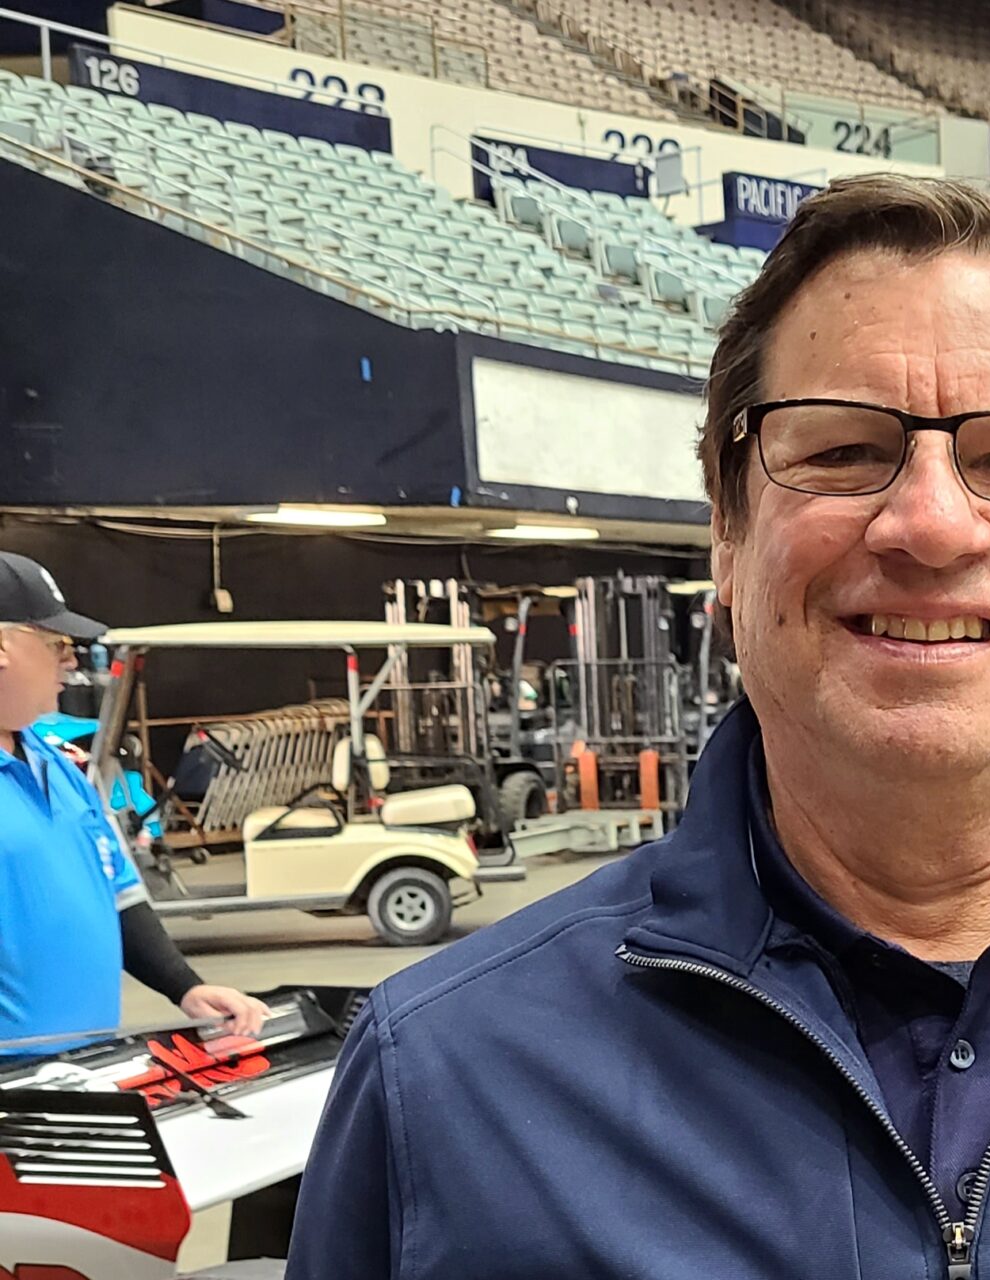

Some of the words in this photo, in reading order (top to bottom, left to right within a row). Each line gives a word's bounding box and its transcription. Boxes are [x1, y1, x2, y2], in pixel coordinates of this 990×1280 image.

[84, 55, 140, 96] 126
[834, 120, 893, 159] 224
[736, 175, 803, 220] PACIFIC
